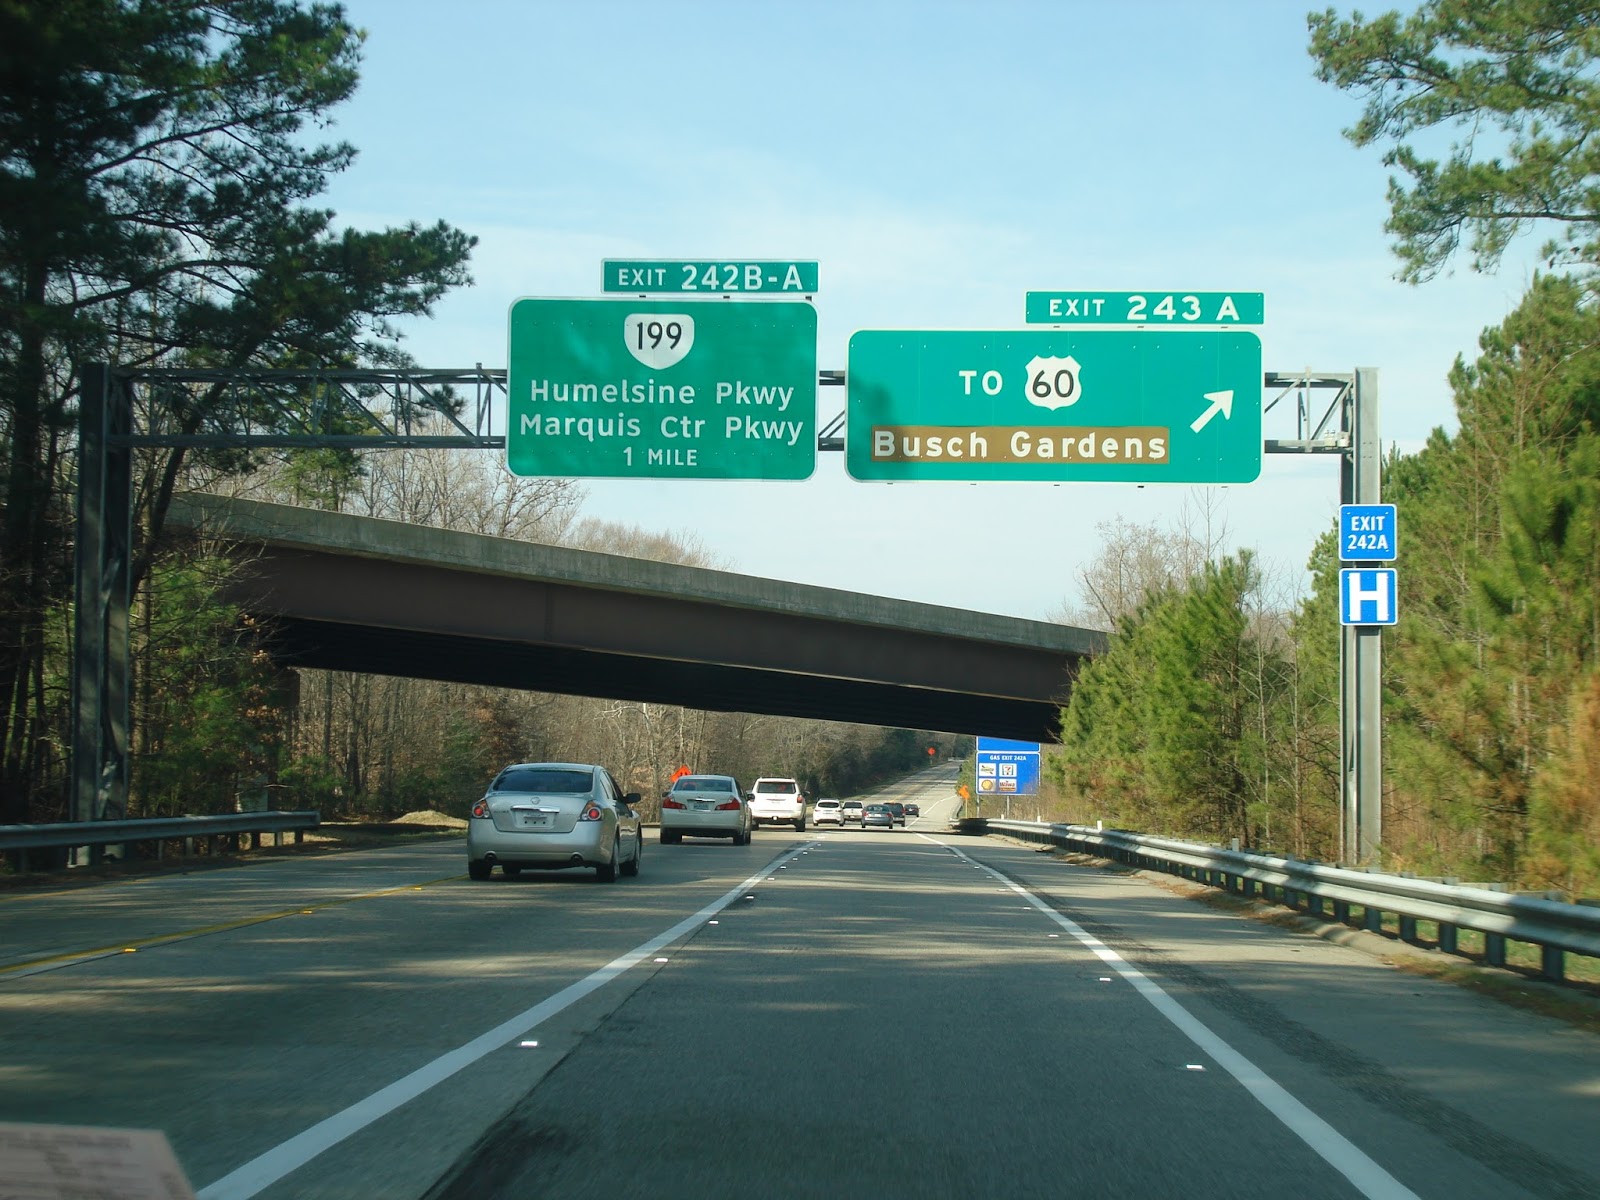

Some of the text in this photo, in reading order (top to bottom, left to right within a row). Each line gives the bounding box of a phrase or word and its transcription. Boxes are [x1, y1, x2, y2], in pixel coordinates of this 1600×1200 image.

[618, 265, 803, 290] EXIT 242B-A
[1049, 296, 1240, 321] EXIT 243 A
[636, 322, 682, 350] 199
[531, 379, 794, 411] Humelsine Pkwy
[958, 370, 1003, 396] TO
[1032, 369, 1075, 398] 60
[520, 412, 803, 446] Marquis Ctr Pkwy
[623, 447, 698, 467] 1 MILE
[873, 430, 1166, 459] Busch Gardens
[1347, 516, 1388, 549] EXIT 242A
[1348, 572, 1389, 622] H
